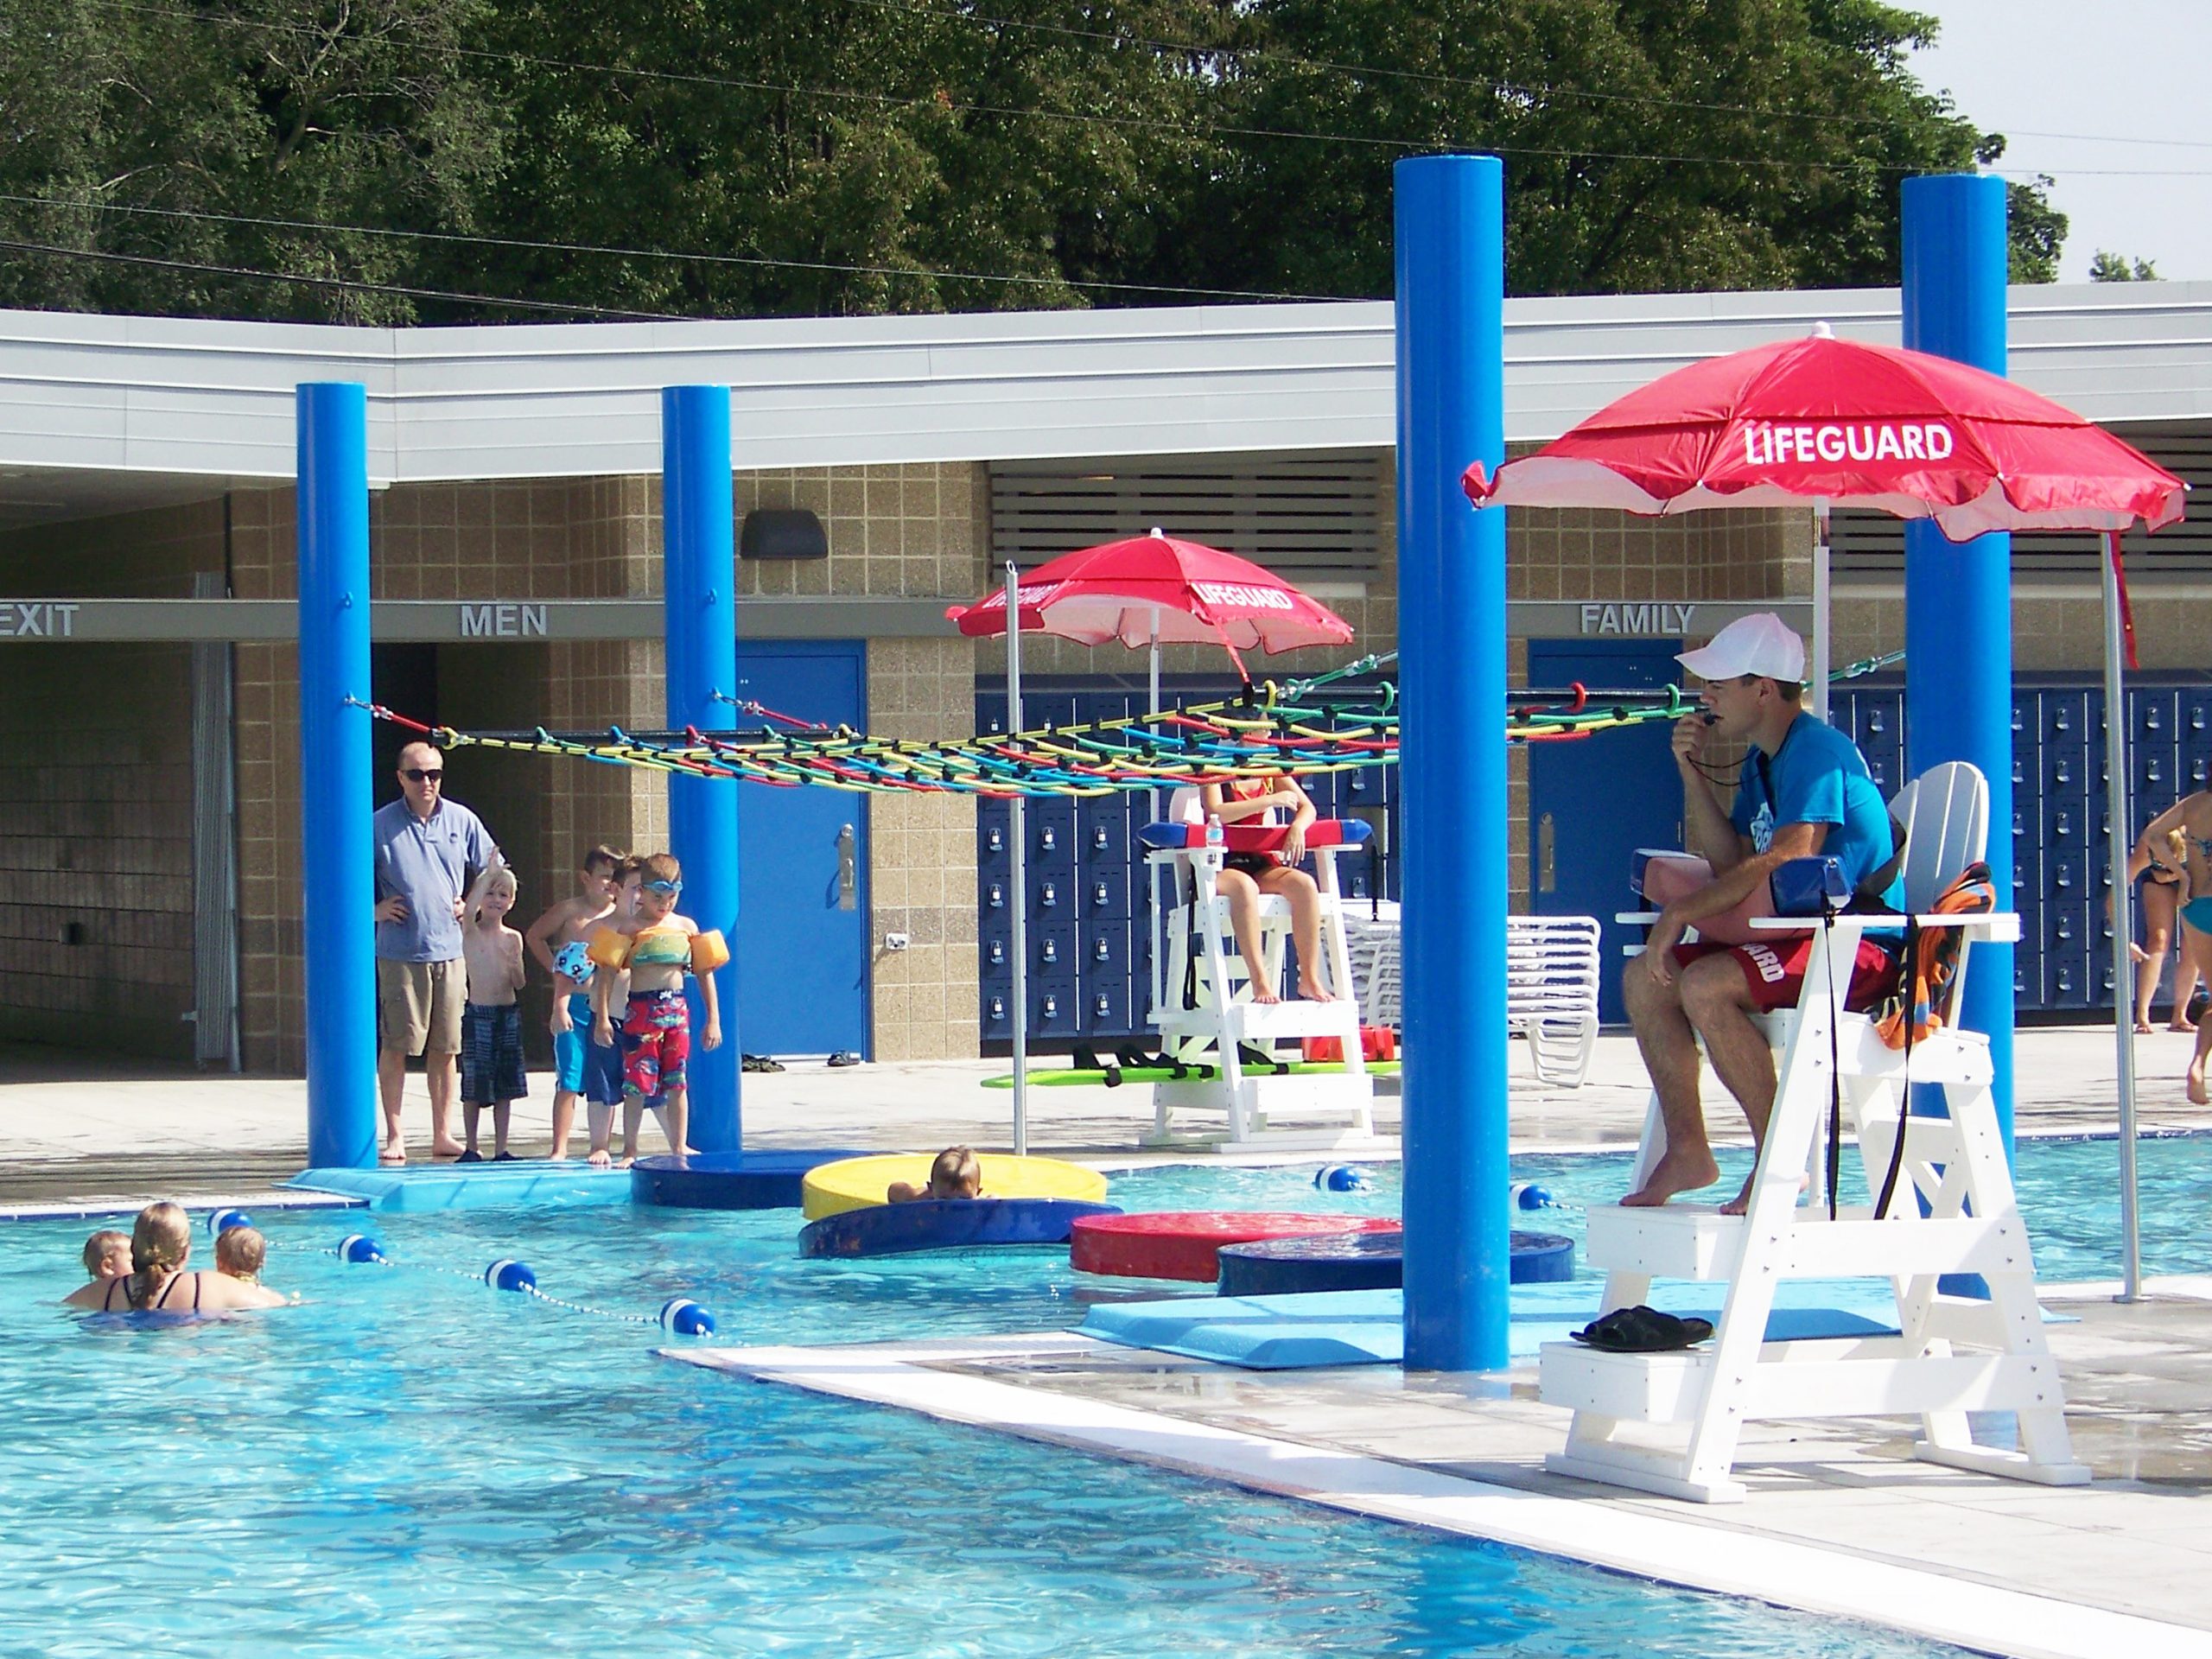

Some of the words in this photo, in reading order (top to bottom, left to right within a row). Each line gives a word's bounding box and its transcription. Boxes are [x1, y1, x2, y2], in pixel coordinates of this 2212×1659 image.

[1744, 424, 1953, 465] LIFEGUARD
[1191, 582, 1294, 609] LIFEGUARD
[0, 604, 79, 637] EXIT
[461, 605, 547, 636] MEN
[1581, 605, 1696, 634] FAMILY
[1738, 943, 1785, 982] ARD
